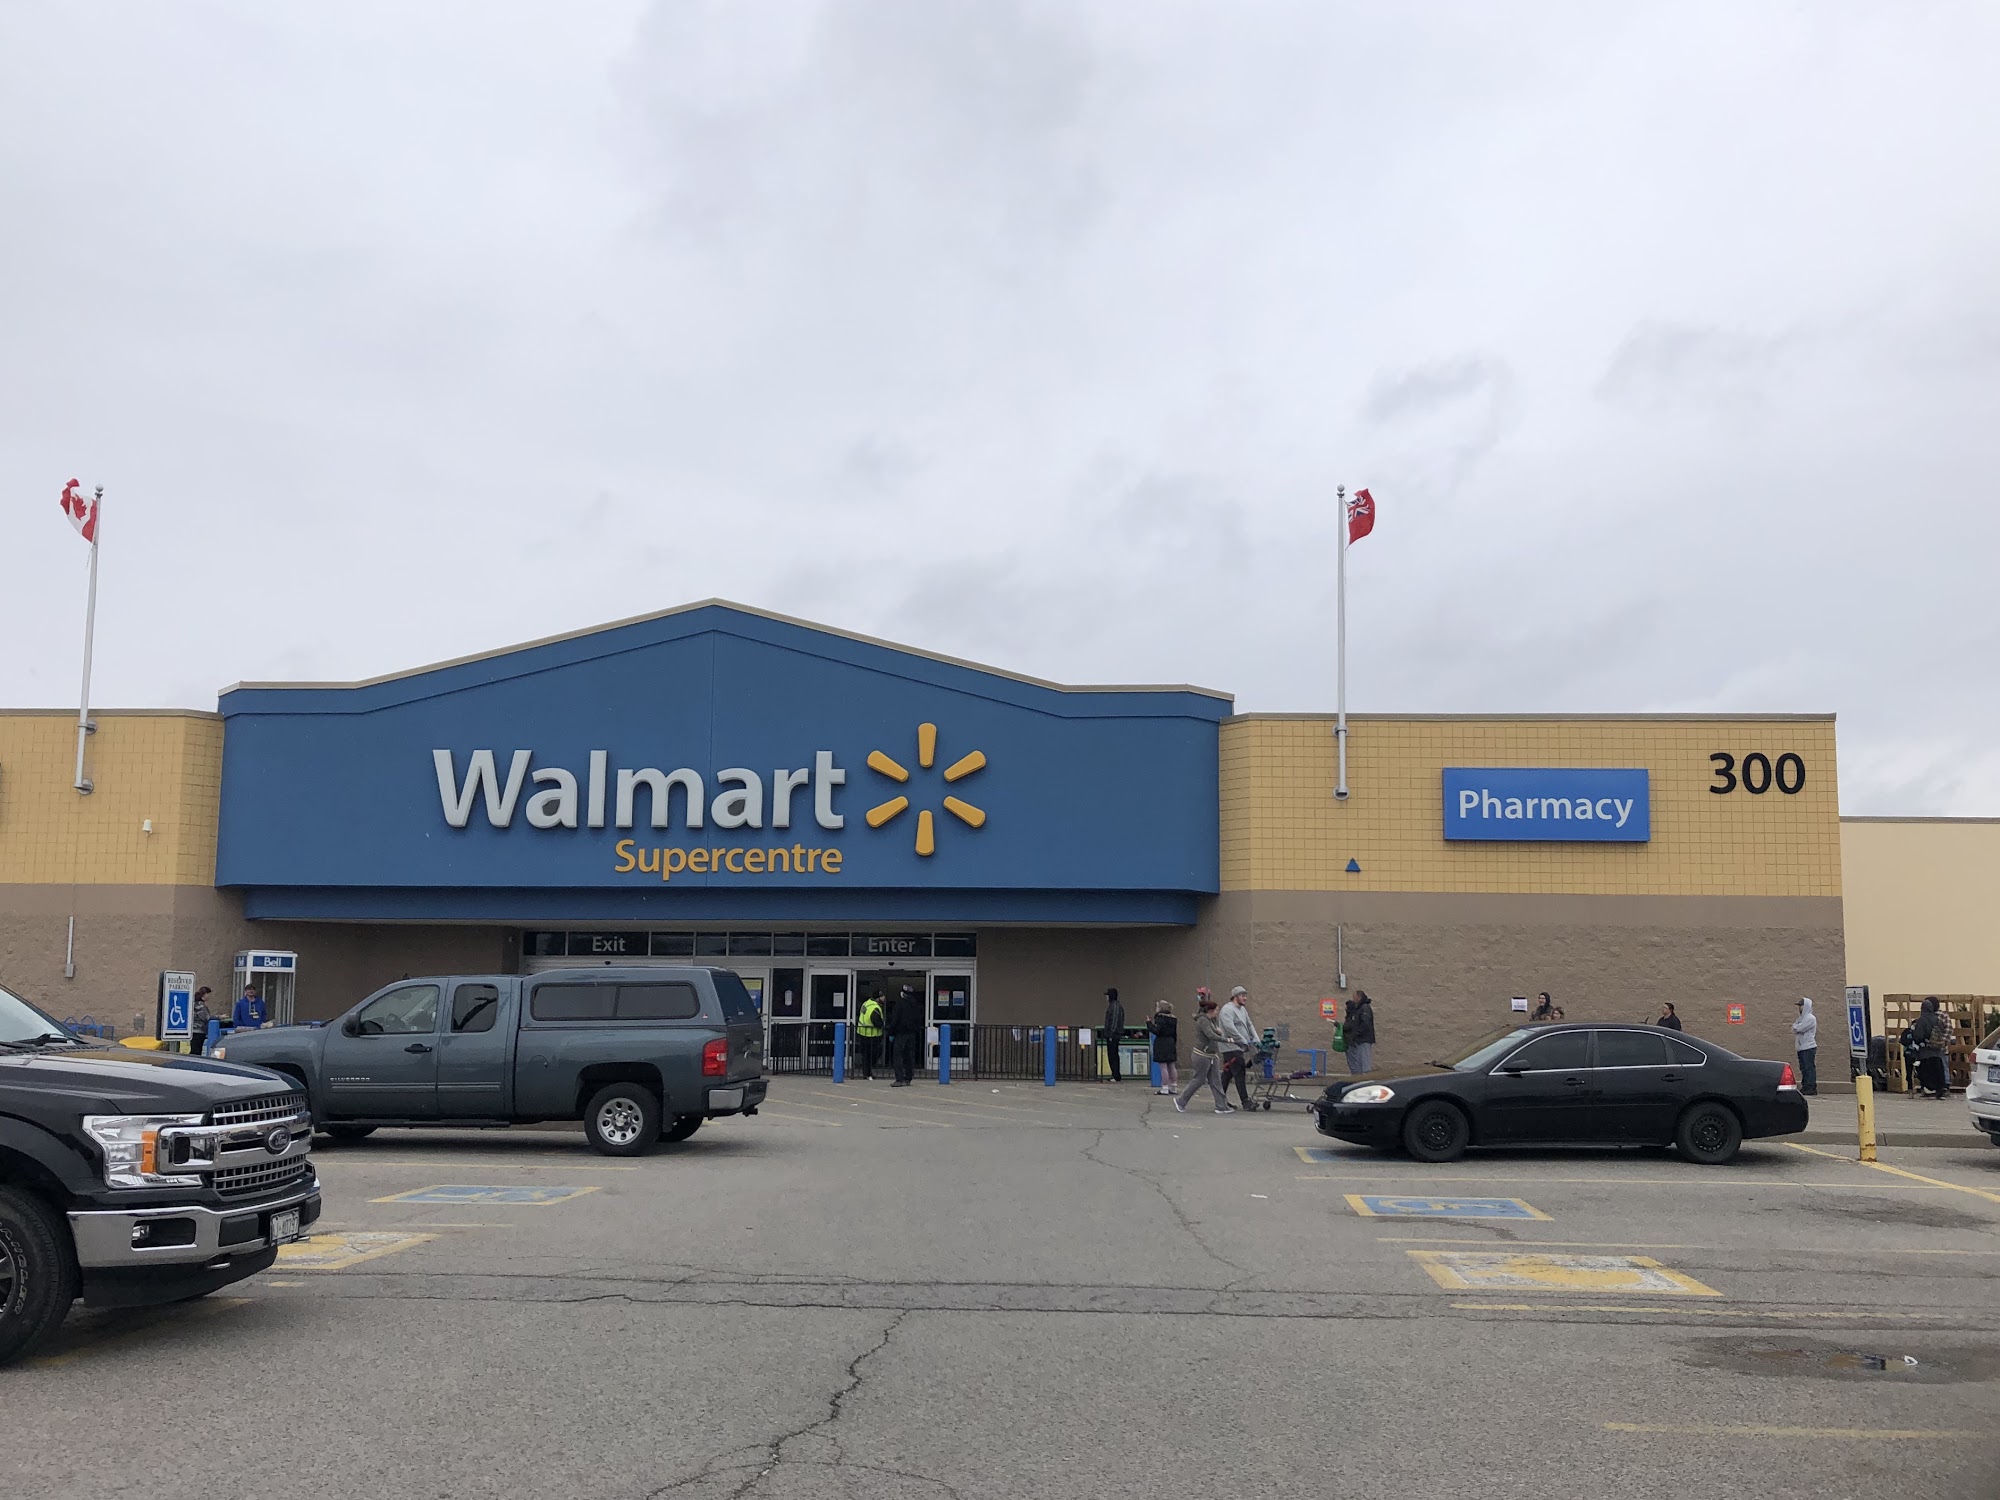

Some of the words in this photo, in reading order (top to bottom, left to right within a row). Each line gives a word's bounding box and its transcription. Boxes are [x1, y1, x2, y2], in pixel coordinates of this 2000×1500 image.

[432, 749, 846, 829] Walmart
[1709, 752, 1806, 794] 300
[1459, 789, 1634, 828] Pharmacy
[614, 839, 843, 881] Supercentre
[263, 956, 282, 967] Bell
[592, 936, 626, 952] Exit
[868, 937, 916, 953] Enter
